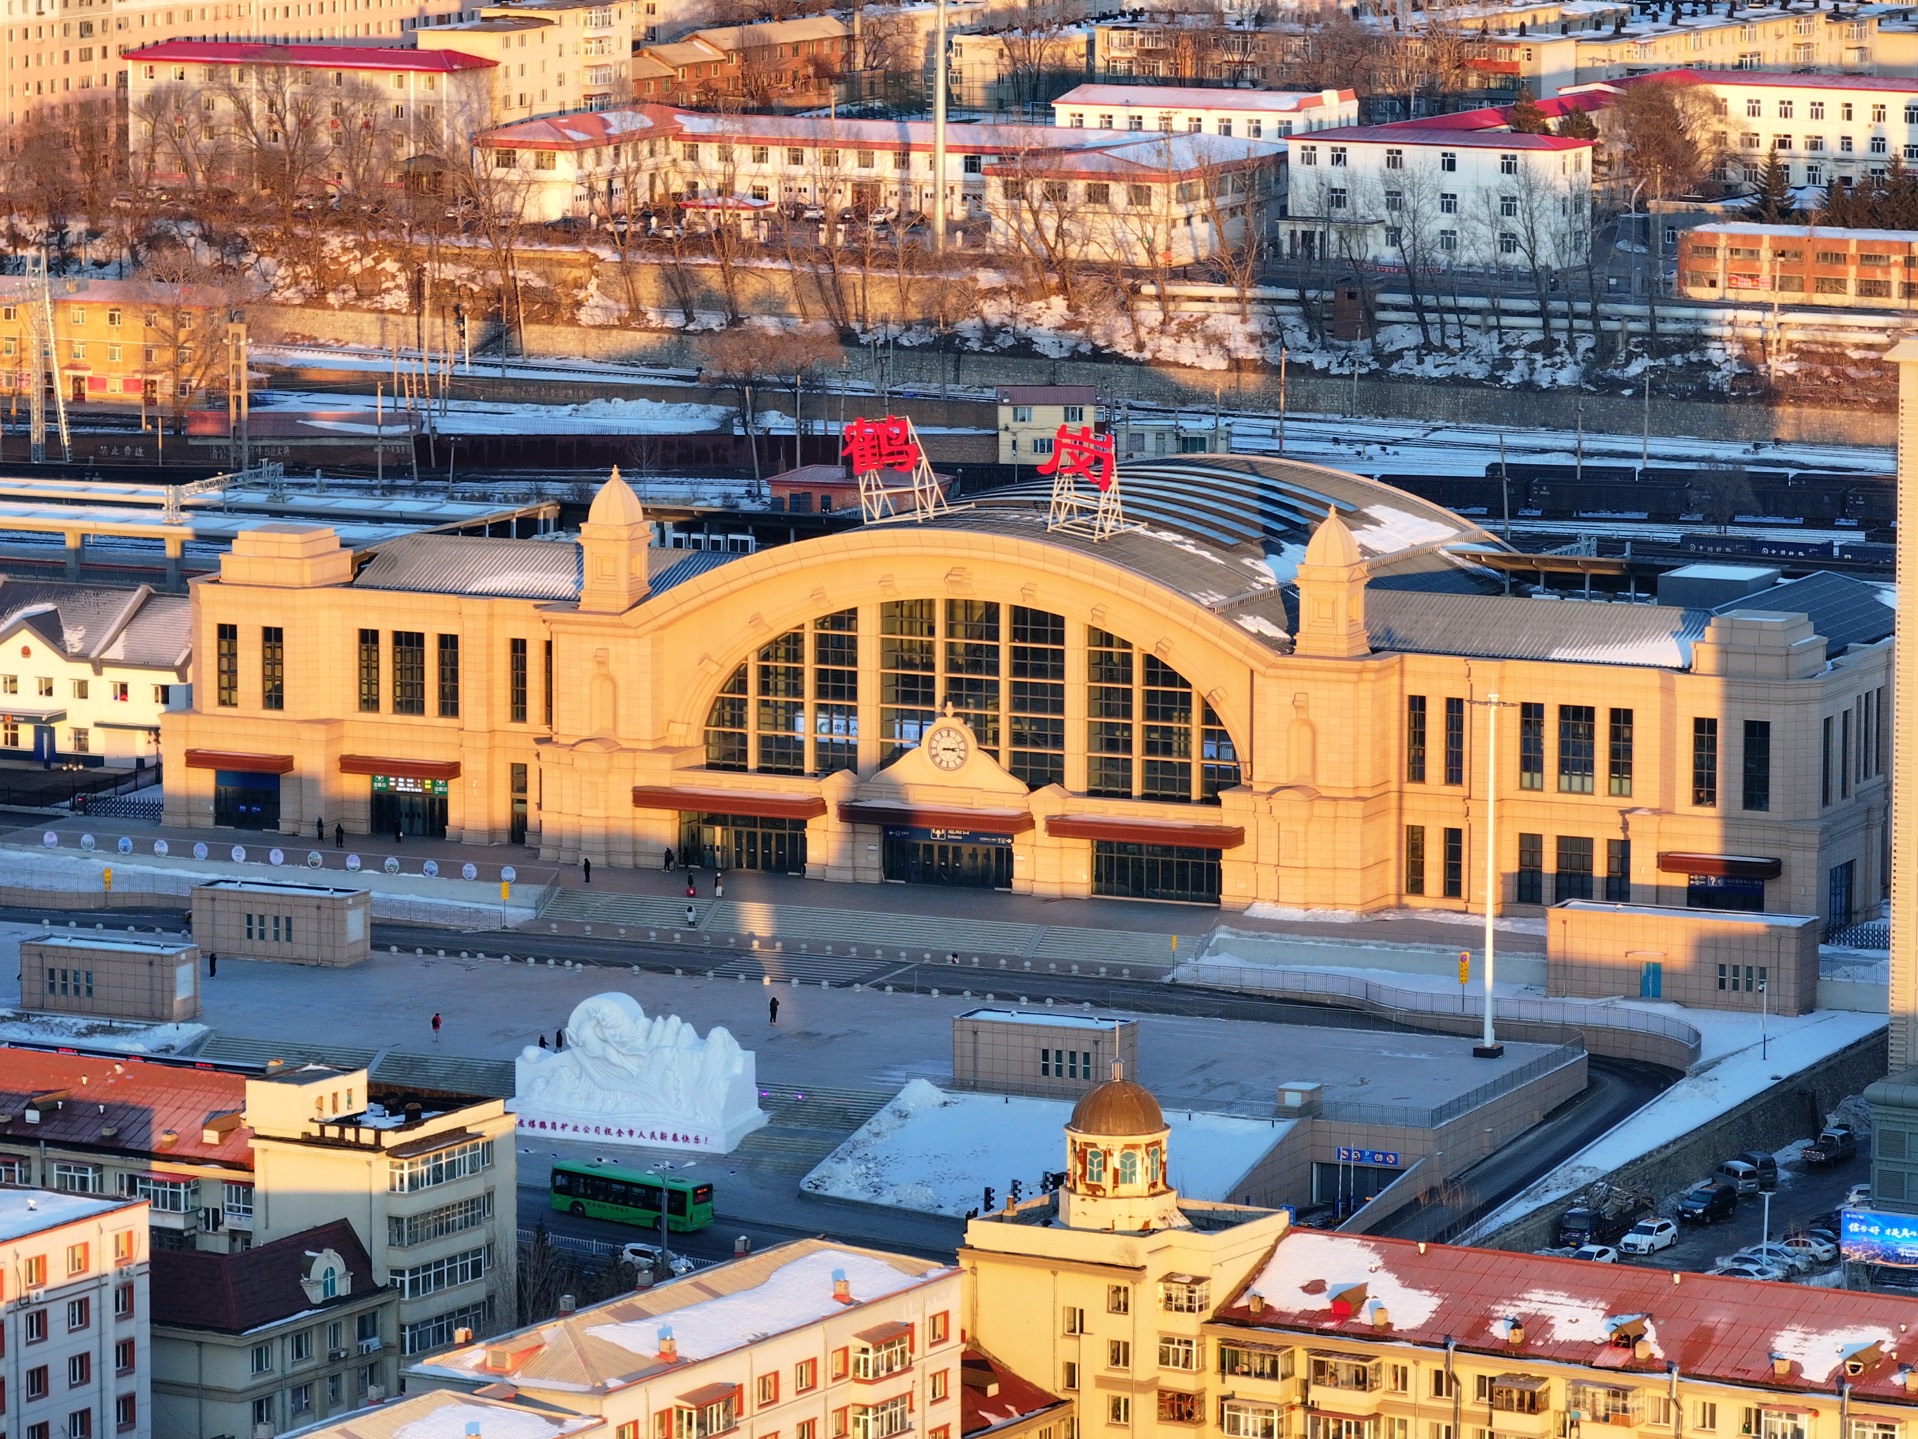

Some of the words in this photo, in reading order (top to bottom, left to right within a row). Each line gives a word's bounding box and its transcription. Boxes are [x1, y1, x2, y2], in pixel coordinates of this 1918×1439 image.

[98, 445, 145, 457] 禁止靠近
[1884, 1227, 1918, 1239] 才是真的
